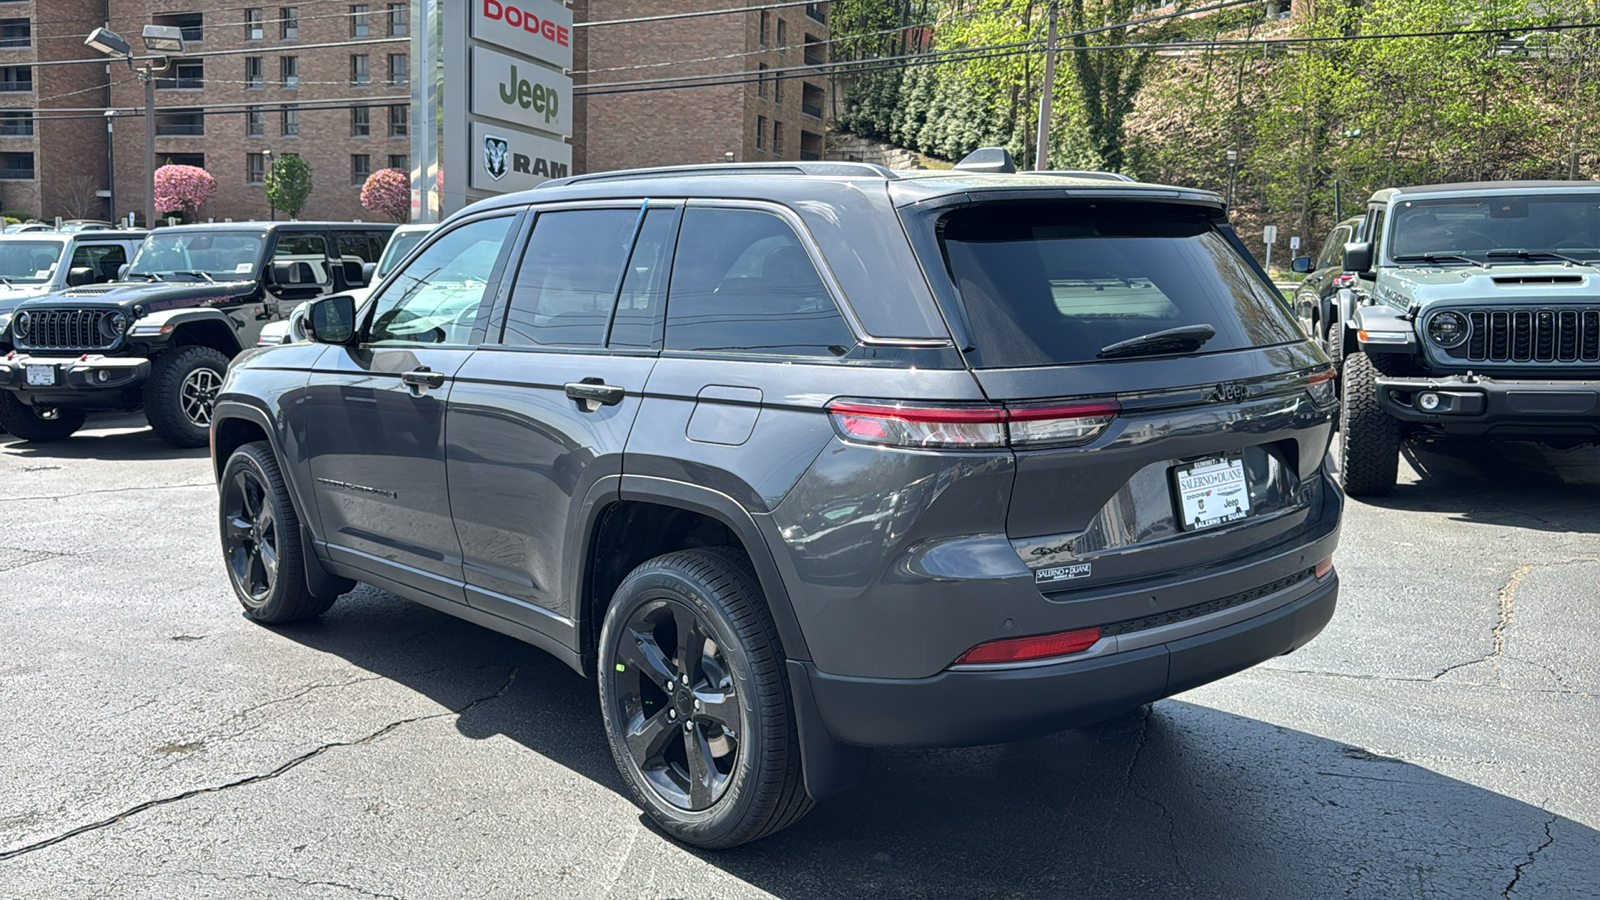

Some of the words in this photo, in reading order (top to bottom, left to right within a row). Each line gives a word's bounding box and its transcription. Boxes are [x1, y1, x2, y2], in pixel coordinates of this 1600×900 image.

[483, 0, 569, 47] DODGE
[499, 64, 559, 124] Jeep
[513, 153, 567, 179] RAM
[1212, 383, 1249, 404] Jeep
[1181, 474, 1214, 491] SALERNO
[1217, 468, 1242, 482] DUANE
[1224, 498, 1239, 508] Jeep
[1194, 517, 1221, 529] SALERNO
[1228, 511, 1247, 520] DUANE
